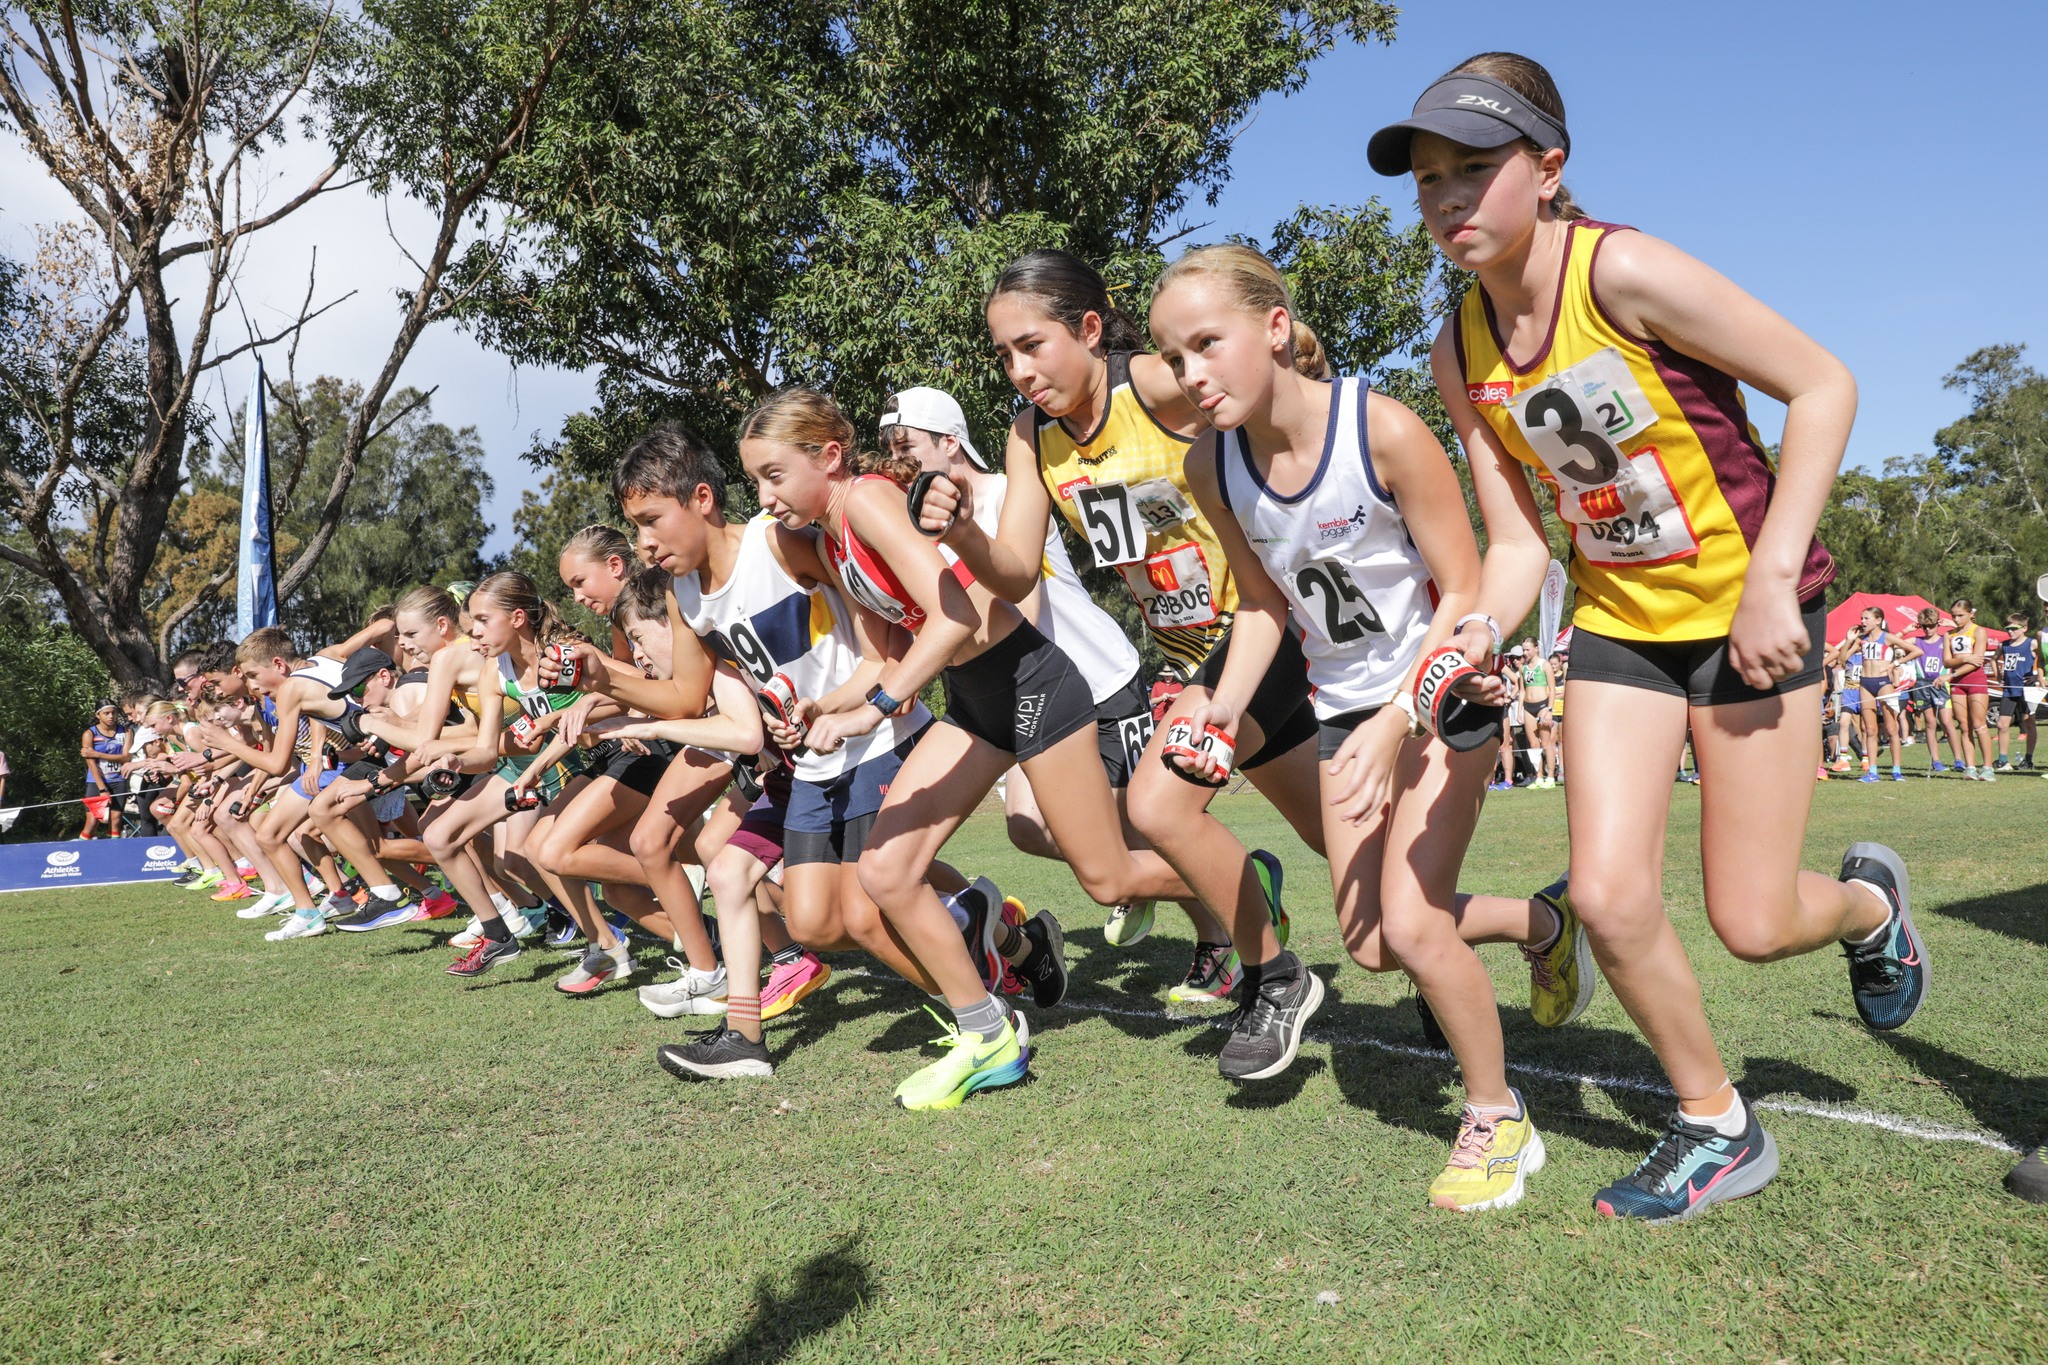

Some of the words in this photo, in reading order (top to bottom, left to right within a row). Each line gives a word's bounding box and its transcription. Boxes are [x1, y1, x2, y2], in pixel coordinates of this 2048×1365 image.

[1456, 94, 1512, 115] 2XU
[1469, 384, 1508, 401] coles
[1595, 402, 1625, 429] 2
[1525, 387, 1619, 485] 3
[1077, 483, 1137, 562] 57
[1148, 505, 1176, 524] 13
[1317, 517, 1349, 529] kembla
[1320, 524, 1360, 540] joggers
[1143, 583, 1210, 616] 29806
[1296, 562, 1386, 644] 25
[1865, 643, 1876, 659] 11
[1954, 636, 1964, 651] 3
[1926, 658, 1938, 672] 46
[2005, 655, 2017, 669] 52
[1419, 654, 1462, 710] 0003
[1124, 715, 1152, 774] 65
[43, 866, 81, 874] Athletics
[143, 860, 177, 868] Athletics
